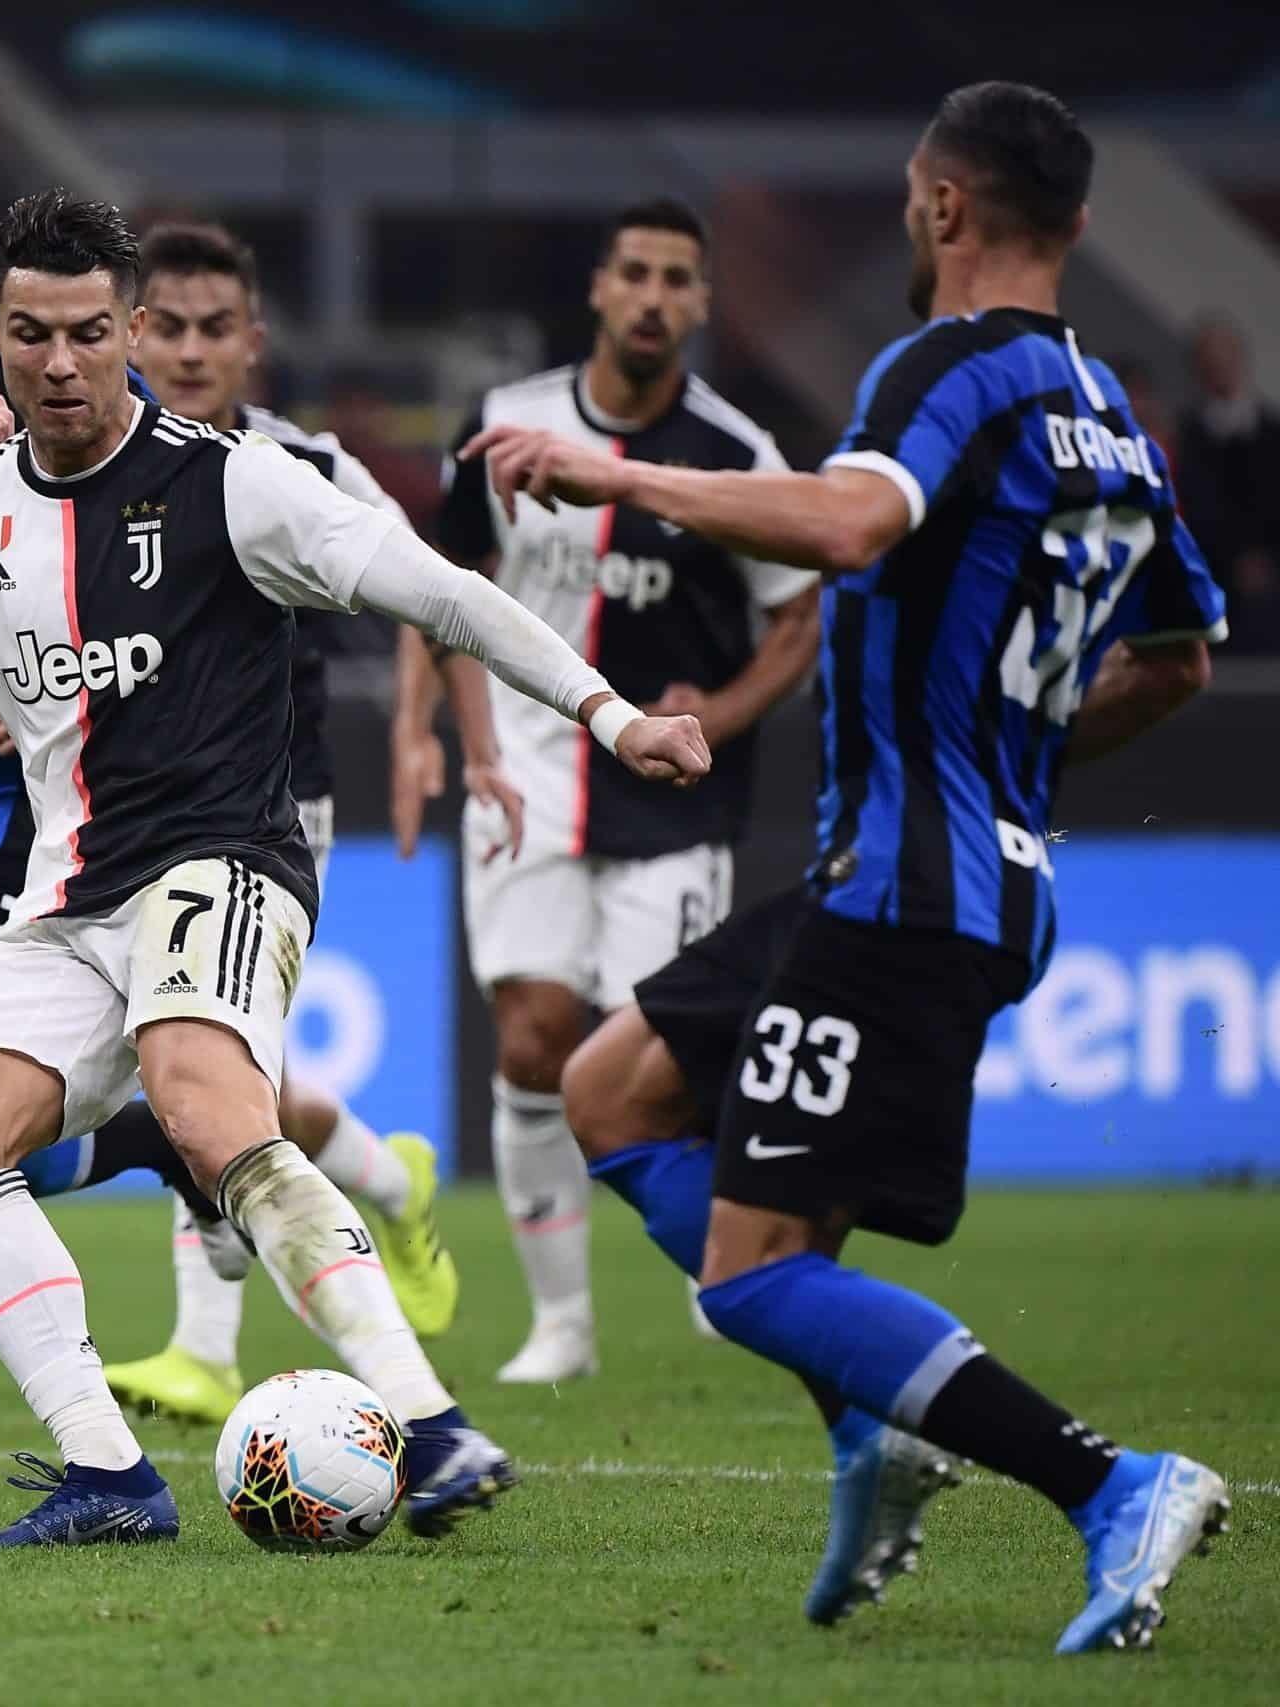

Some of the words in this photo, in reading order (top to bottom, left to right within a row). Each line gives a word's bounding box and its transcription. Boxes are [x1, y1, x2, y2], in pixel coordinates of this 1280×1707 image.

[2, 629, 164, 704] Jeep
[167, 889, 215, 953] 7
[152, 983, 199, 995] adidas
[739, 1003, 861, 1118] 33
